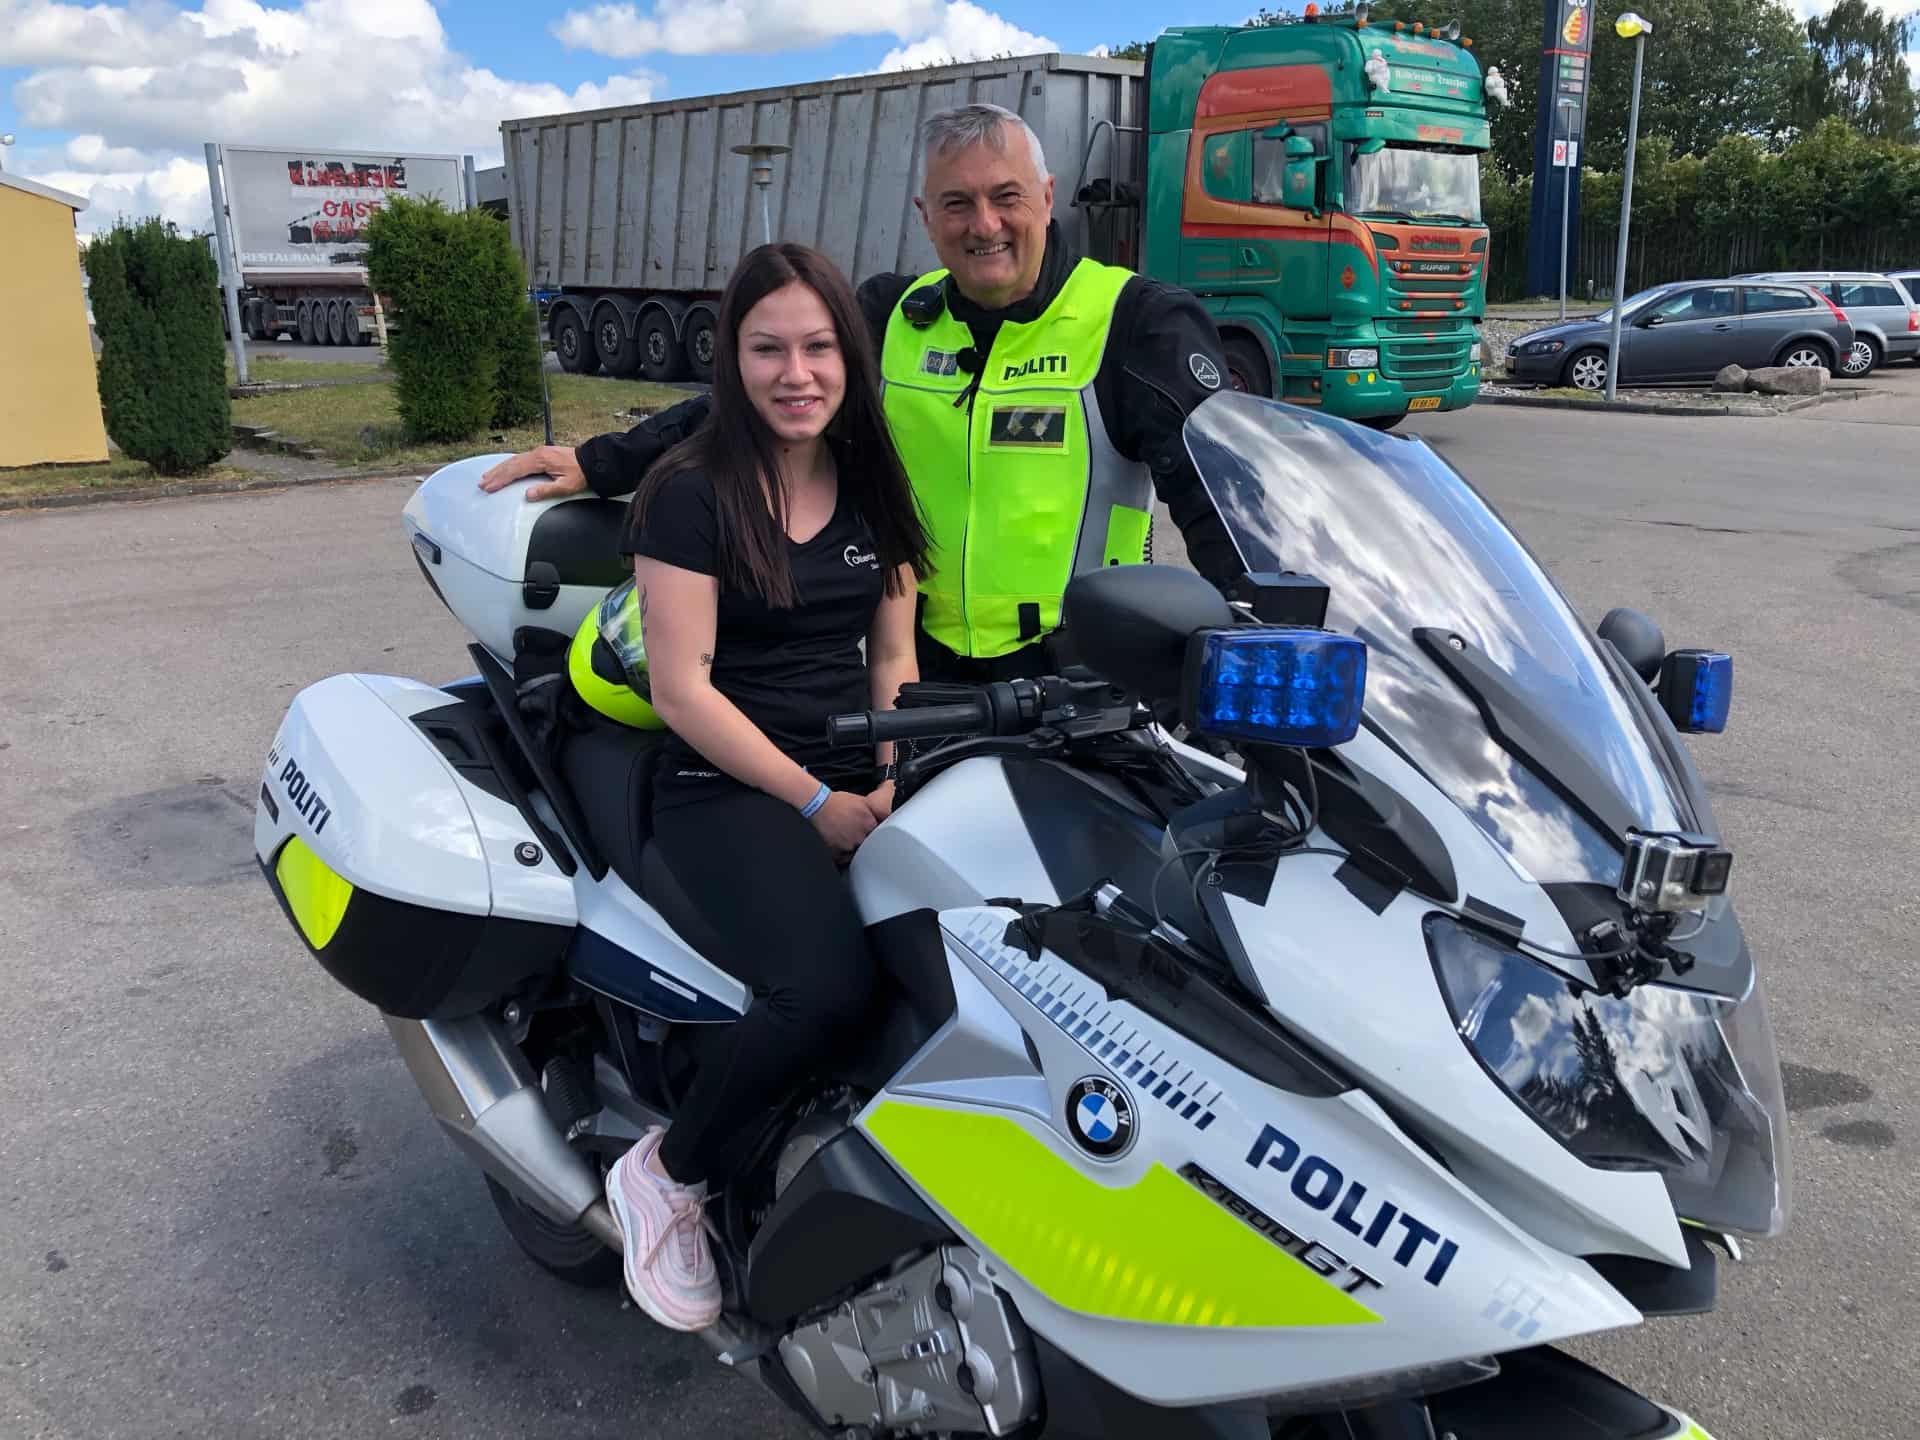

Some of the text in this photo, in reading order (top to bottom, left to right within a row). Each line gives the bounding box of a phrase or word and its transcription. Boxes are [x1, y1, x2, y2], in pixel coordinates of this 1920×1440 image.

[241, 252, 329, 265] RESTAURANT
[1003, 354, 1068, 381] POLITI
[279, 757, 332, 835] POLITI
[1083, 1079, 1130, 1127] BMW
[1245, 1123, 1459, 1287] POLITI
